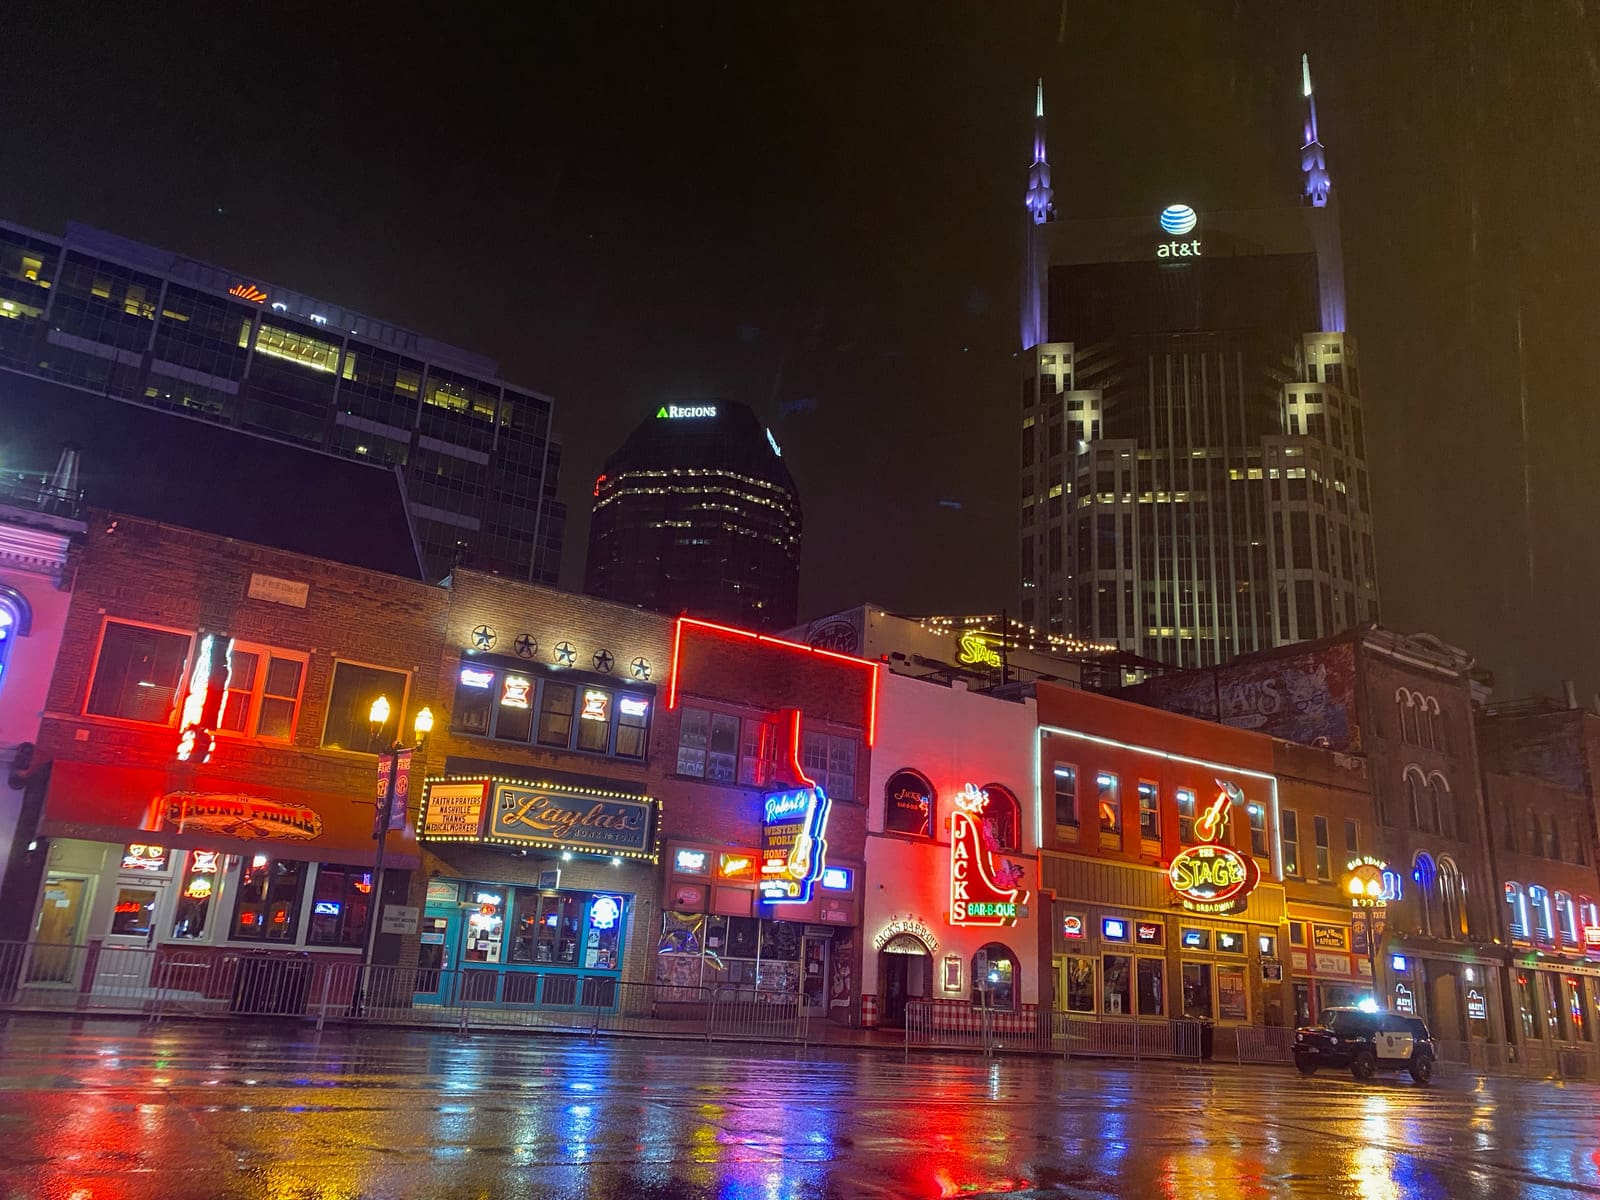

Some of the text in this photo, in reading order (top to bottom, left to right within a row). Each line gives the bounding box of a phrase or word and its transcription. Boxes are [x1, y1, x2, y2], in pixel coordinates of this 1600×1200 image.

[1157, 239, 1202, 258] at&t
[432, 797, 450, 805] FAITH
[455, 797, 481, 805] PRAYERS
[766, 791, 809, 823] Robert's
[169, 799, 316, 834] SECOND FIDDLE
[440, 805, 471, 814] NASHVILLE
[502, 795, 640, 838] Layla's
[443, 814, 466, 824] THANKS
[425, 823, 477, 832] MEDICAL WORKERS
[764, 823, 805, 836] WESTERN
[763, 849, 788, 859] HOME
[954, 820, 970, 921] JACKS
[1346, 856, 1388, 871] BIG TIME
[1173, 855, 1243, 891] STAGE
[967, 903, 1016, 917] BAR-B-QUE
[1196, 899, 1236, 912] BROADWAY
[876, 921, 901, 950] JACK'S
